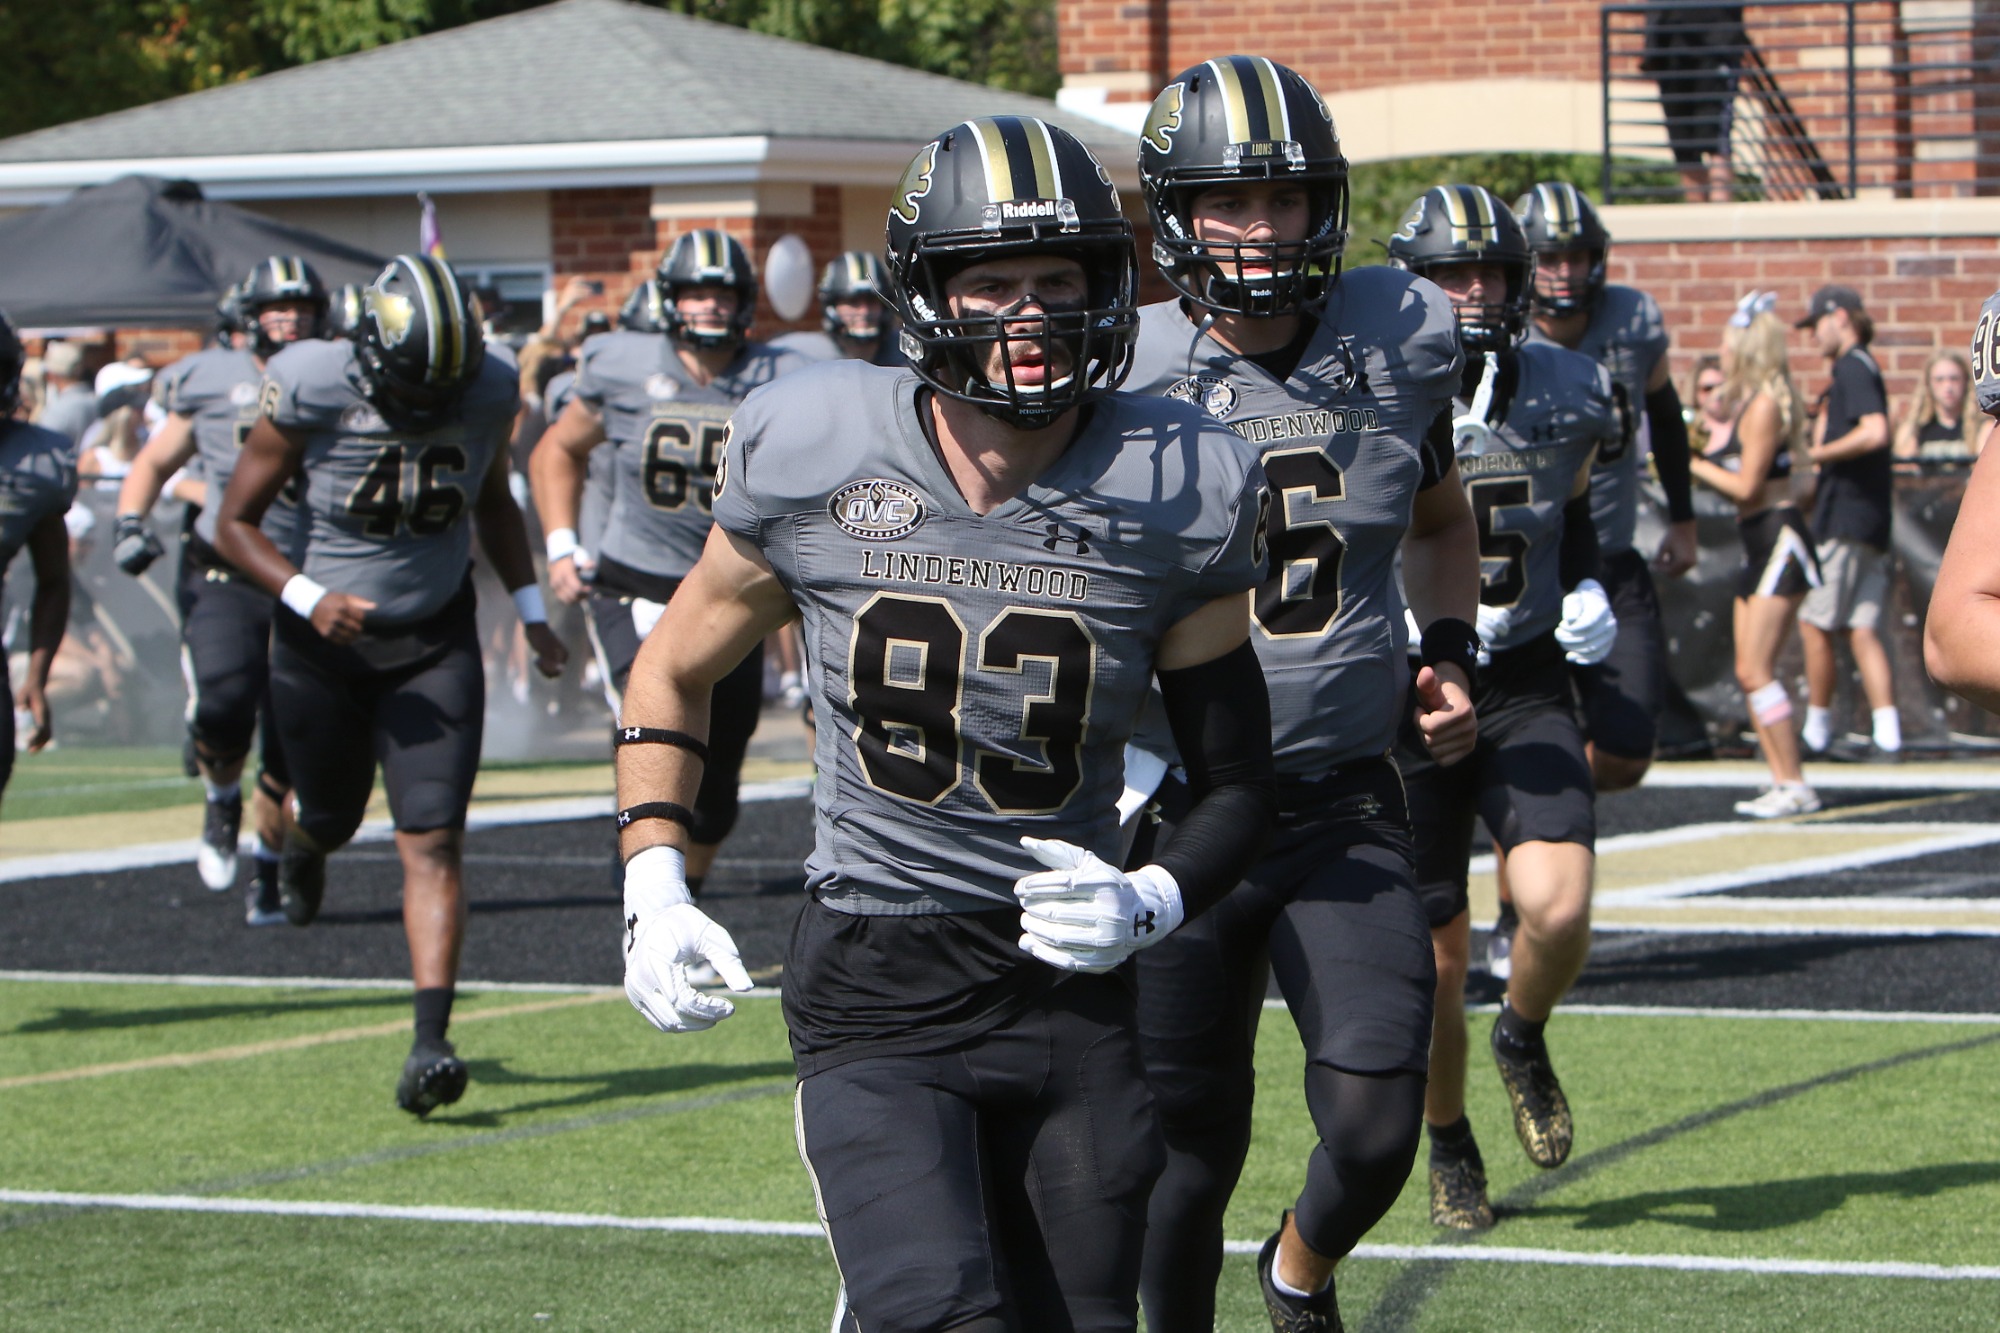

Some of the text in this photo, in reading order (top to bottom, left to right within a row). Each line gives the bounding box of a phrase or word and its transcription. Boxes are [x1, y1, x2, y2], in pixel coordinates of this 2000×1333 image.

[1252, 143, 1273, 156] LIONS
[1002, 201, 1055, 218] Riddell
[1228, 409, 1379, 444] NDENWOOD
[344, 443, 469, 538] 46
[837, 484, 921, 505] OHIO VALLEY
[847, 498, 905, 523] OVC
[840, 521, 913, 538] CONFERENCE
[1250, 446, 1346, 640] 6
[1467, 475, 1533, 608] 5
[861, 549, 1089, 601] LINDENWOOD
[847, 590, 1097, 815] 83
